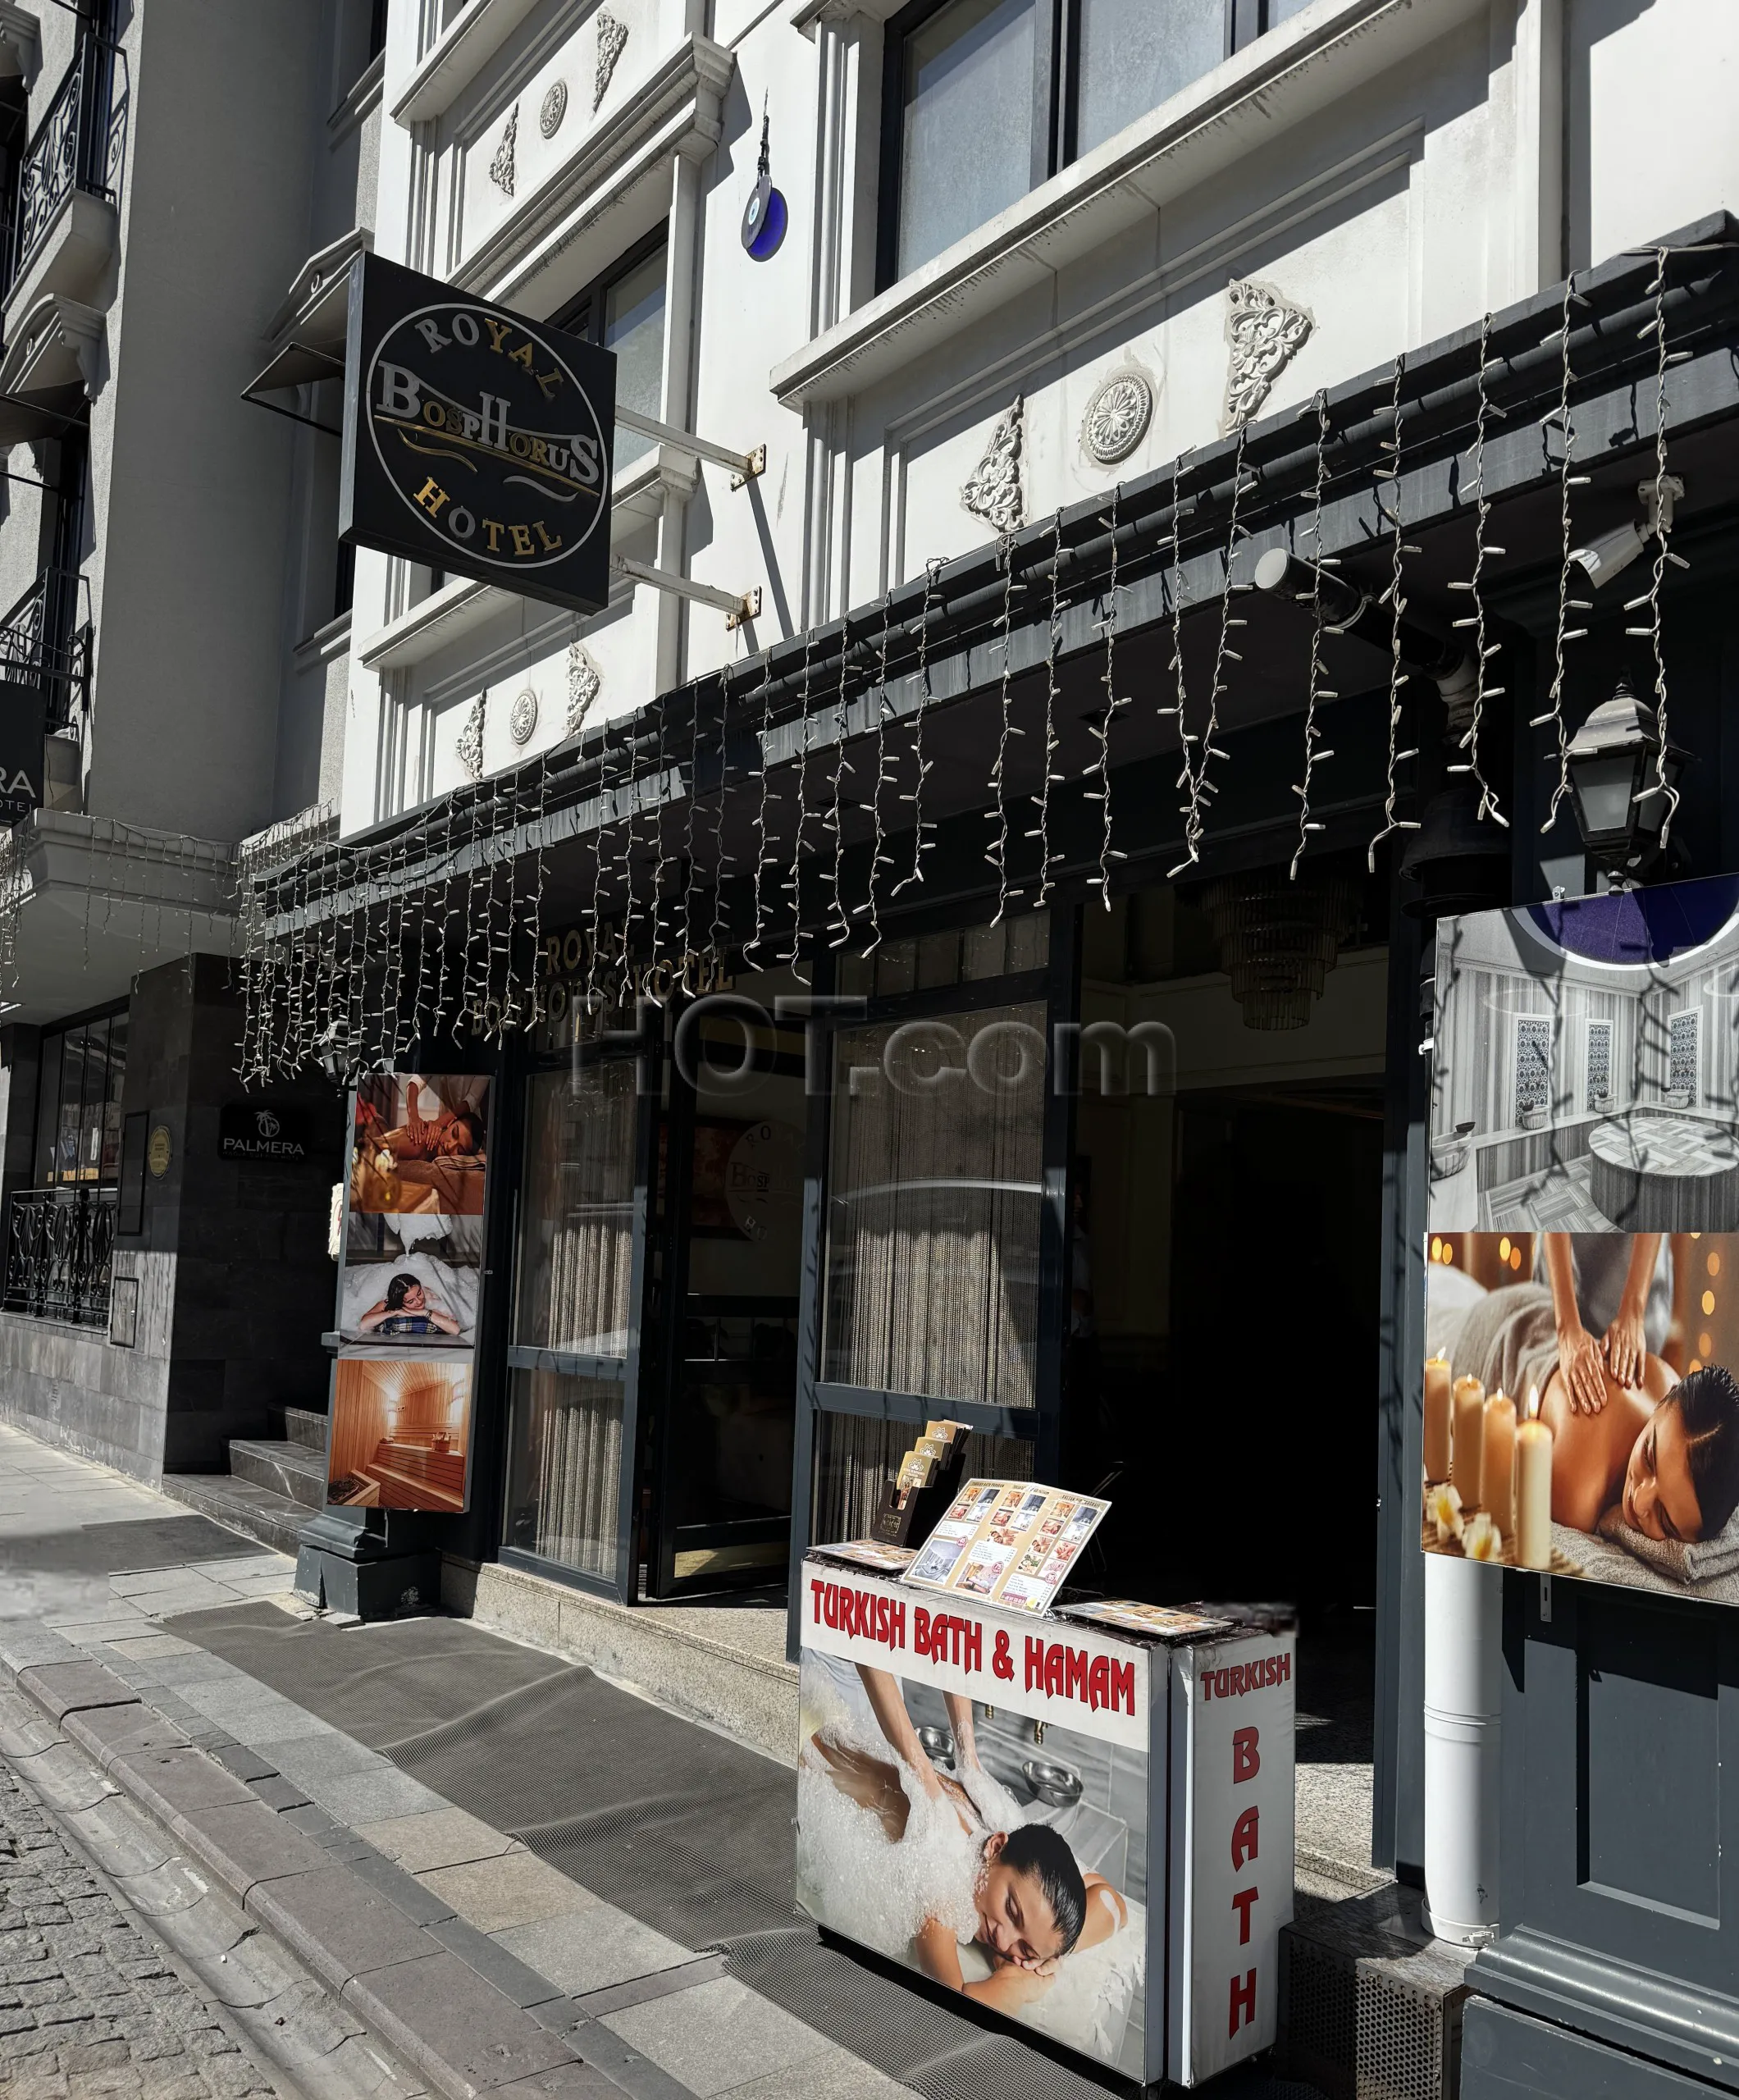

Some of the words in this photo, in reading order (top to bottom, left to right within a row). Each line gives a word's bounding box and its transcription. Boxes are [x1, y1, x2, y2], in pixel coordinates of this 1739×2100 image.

[414, 313, 565, 399] ROYAL
[375, 359, 600, 485] BOSPHORUS
[413, 476, 563, 557] HOTEL
[223, 1137, 304, 1155] PALMERA
[810, 1578, 906, 1652] TURKISH
[915, 1605, 983, 1675] BATH
[992, 1629, 1016, 1682] &
[1025, 1637, 1135, 1717] HAMAM
[1200, 1652, 1291, 1701] TURKISH
[1229, 1726, 1261, 2041] BATH
